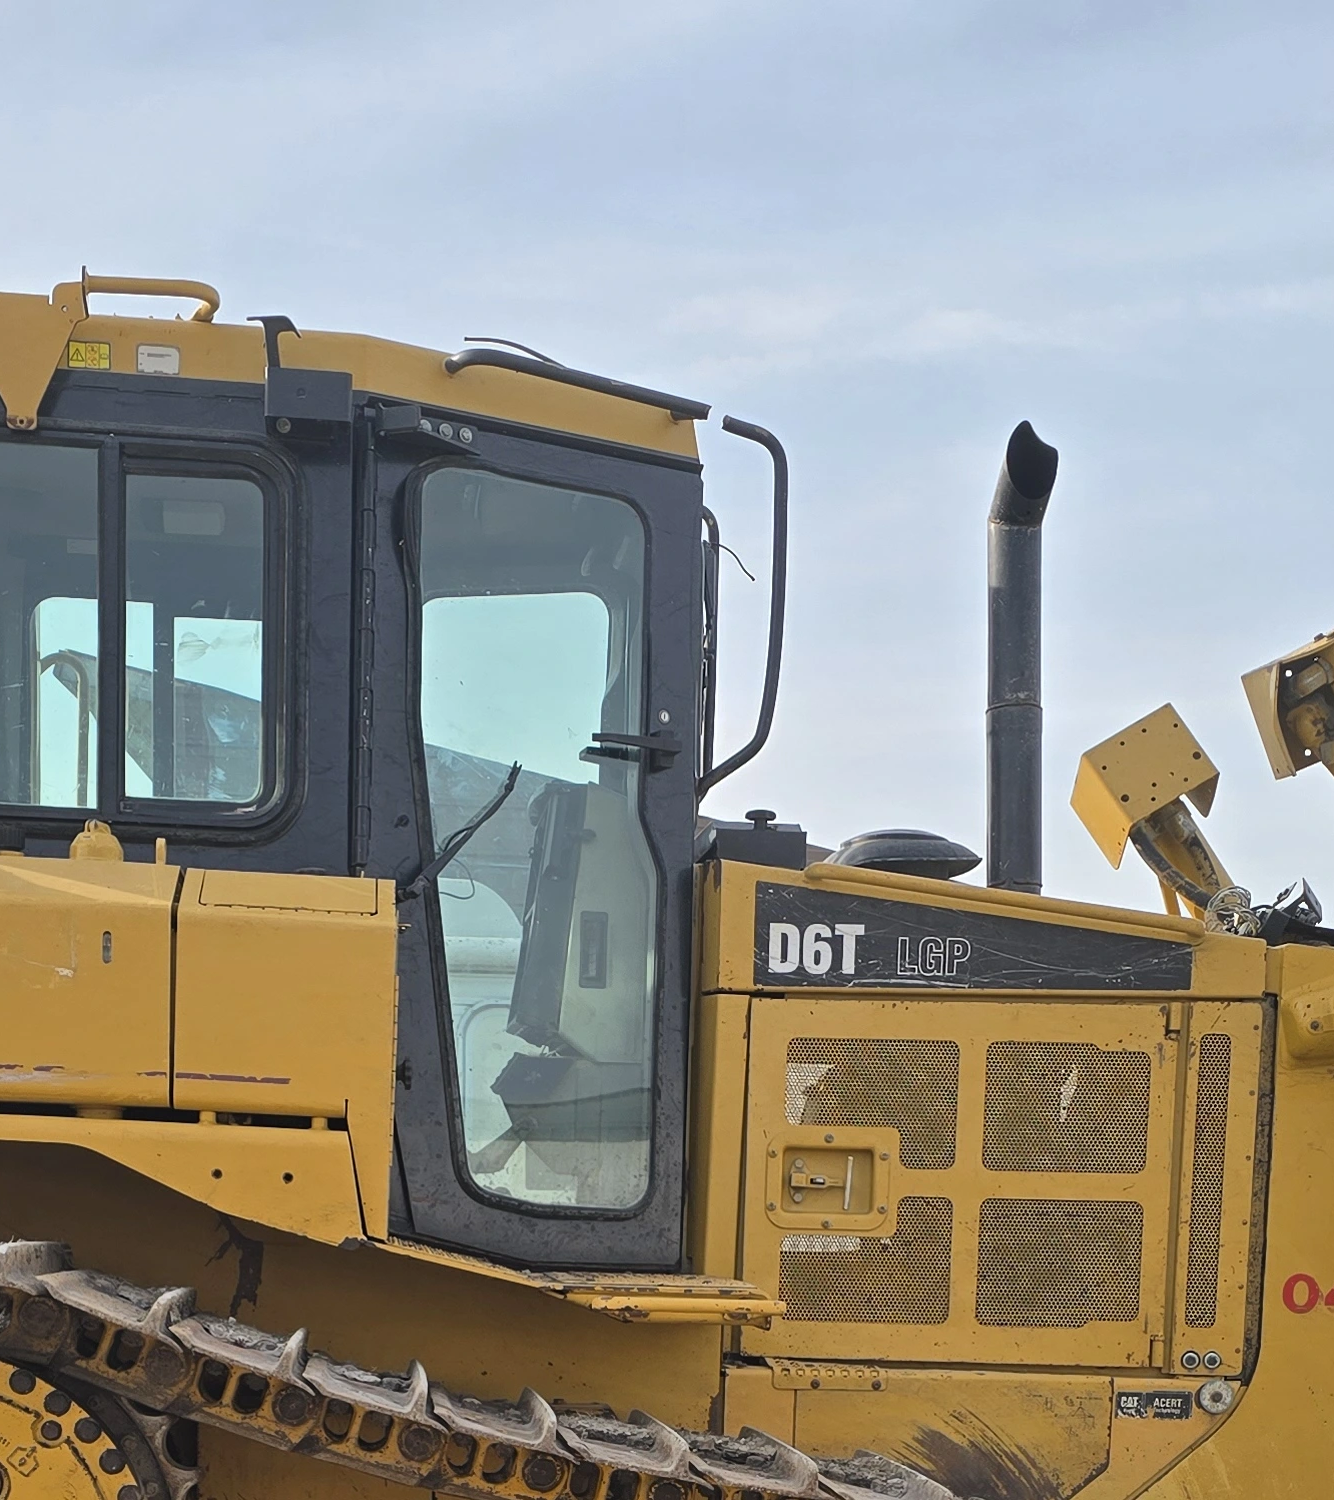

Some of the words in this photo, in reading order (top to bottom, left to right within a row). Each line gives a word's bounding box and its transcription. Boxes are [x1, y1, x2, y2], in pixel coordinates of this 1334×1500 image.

[768, 922, 865, 975] D6T
[896, 936, 971, 977] LGP
[1120, 1396, 1139, 1408] CAT
[1153, 1397, 1183, 1408] ACERT
